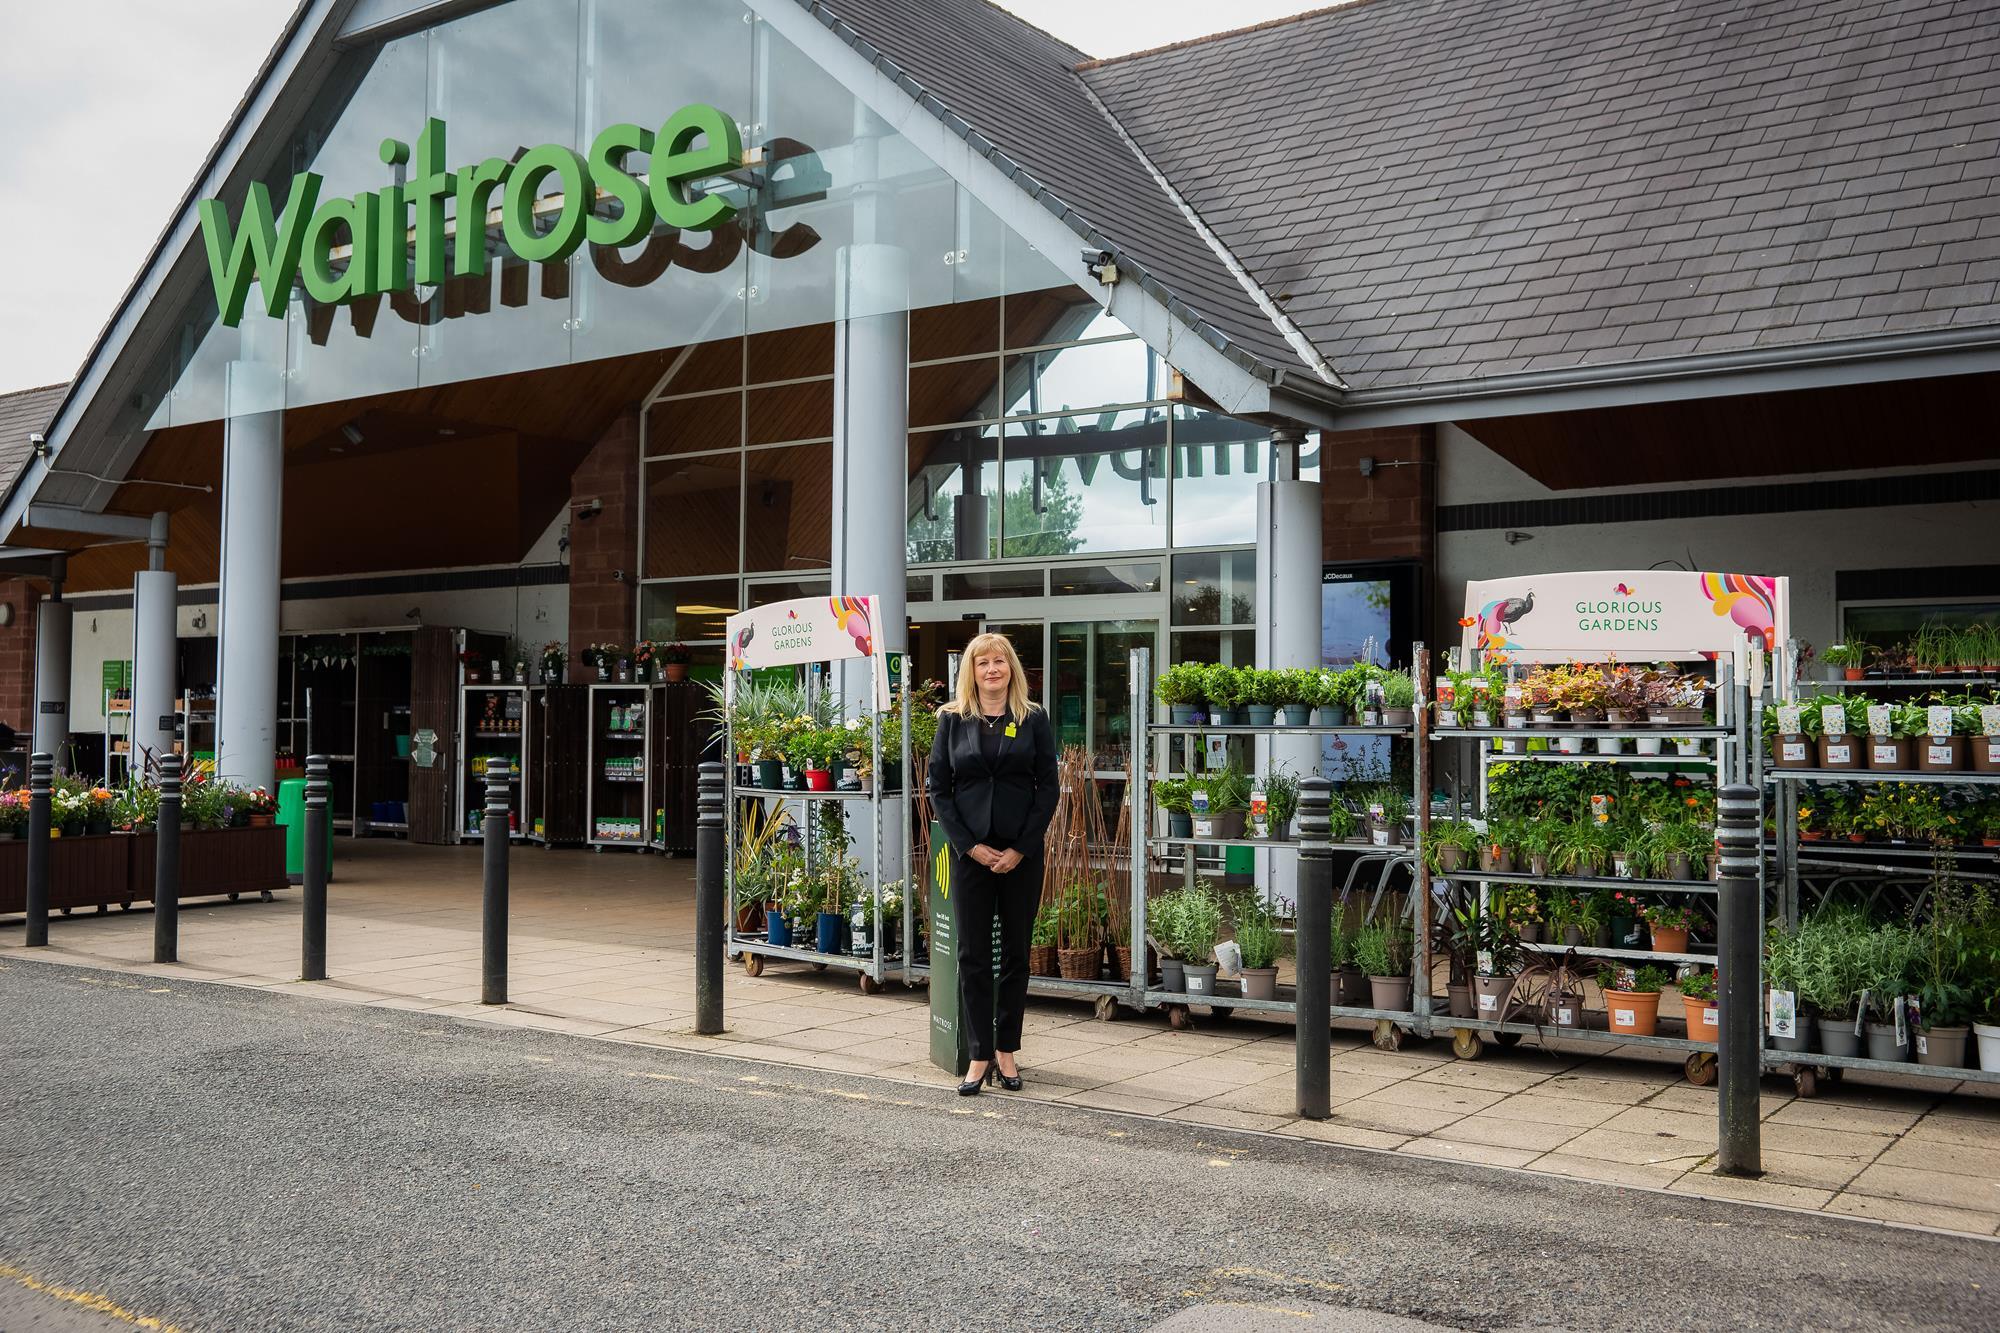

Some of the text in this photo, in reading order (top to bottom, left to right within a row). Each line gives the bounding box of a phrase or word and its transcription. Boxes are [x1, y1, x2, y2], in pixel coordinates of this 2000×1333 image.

[199, 104, 742, 328] Waitrose
[1575, 601, 1662, 614] GLORIOUS
[771, 622, 813, 637] GLORIOUS
[1578, 618, 1658, 631] GARDENS
[774, 636, 812, 650] GARDENS
